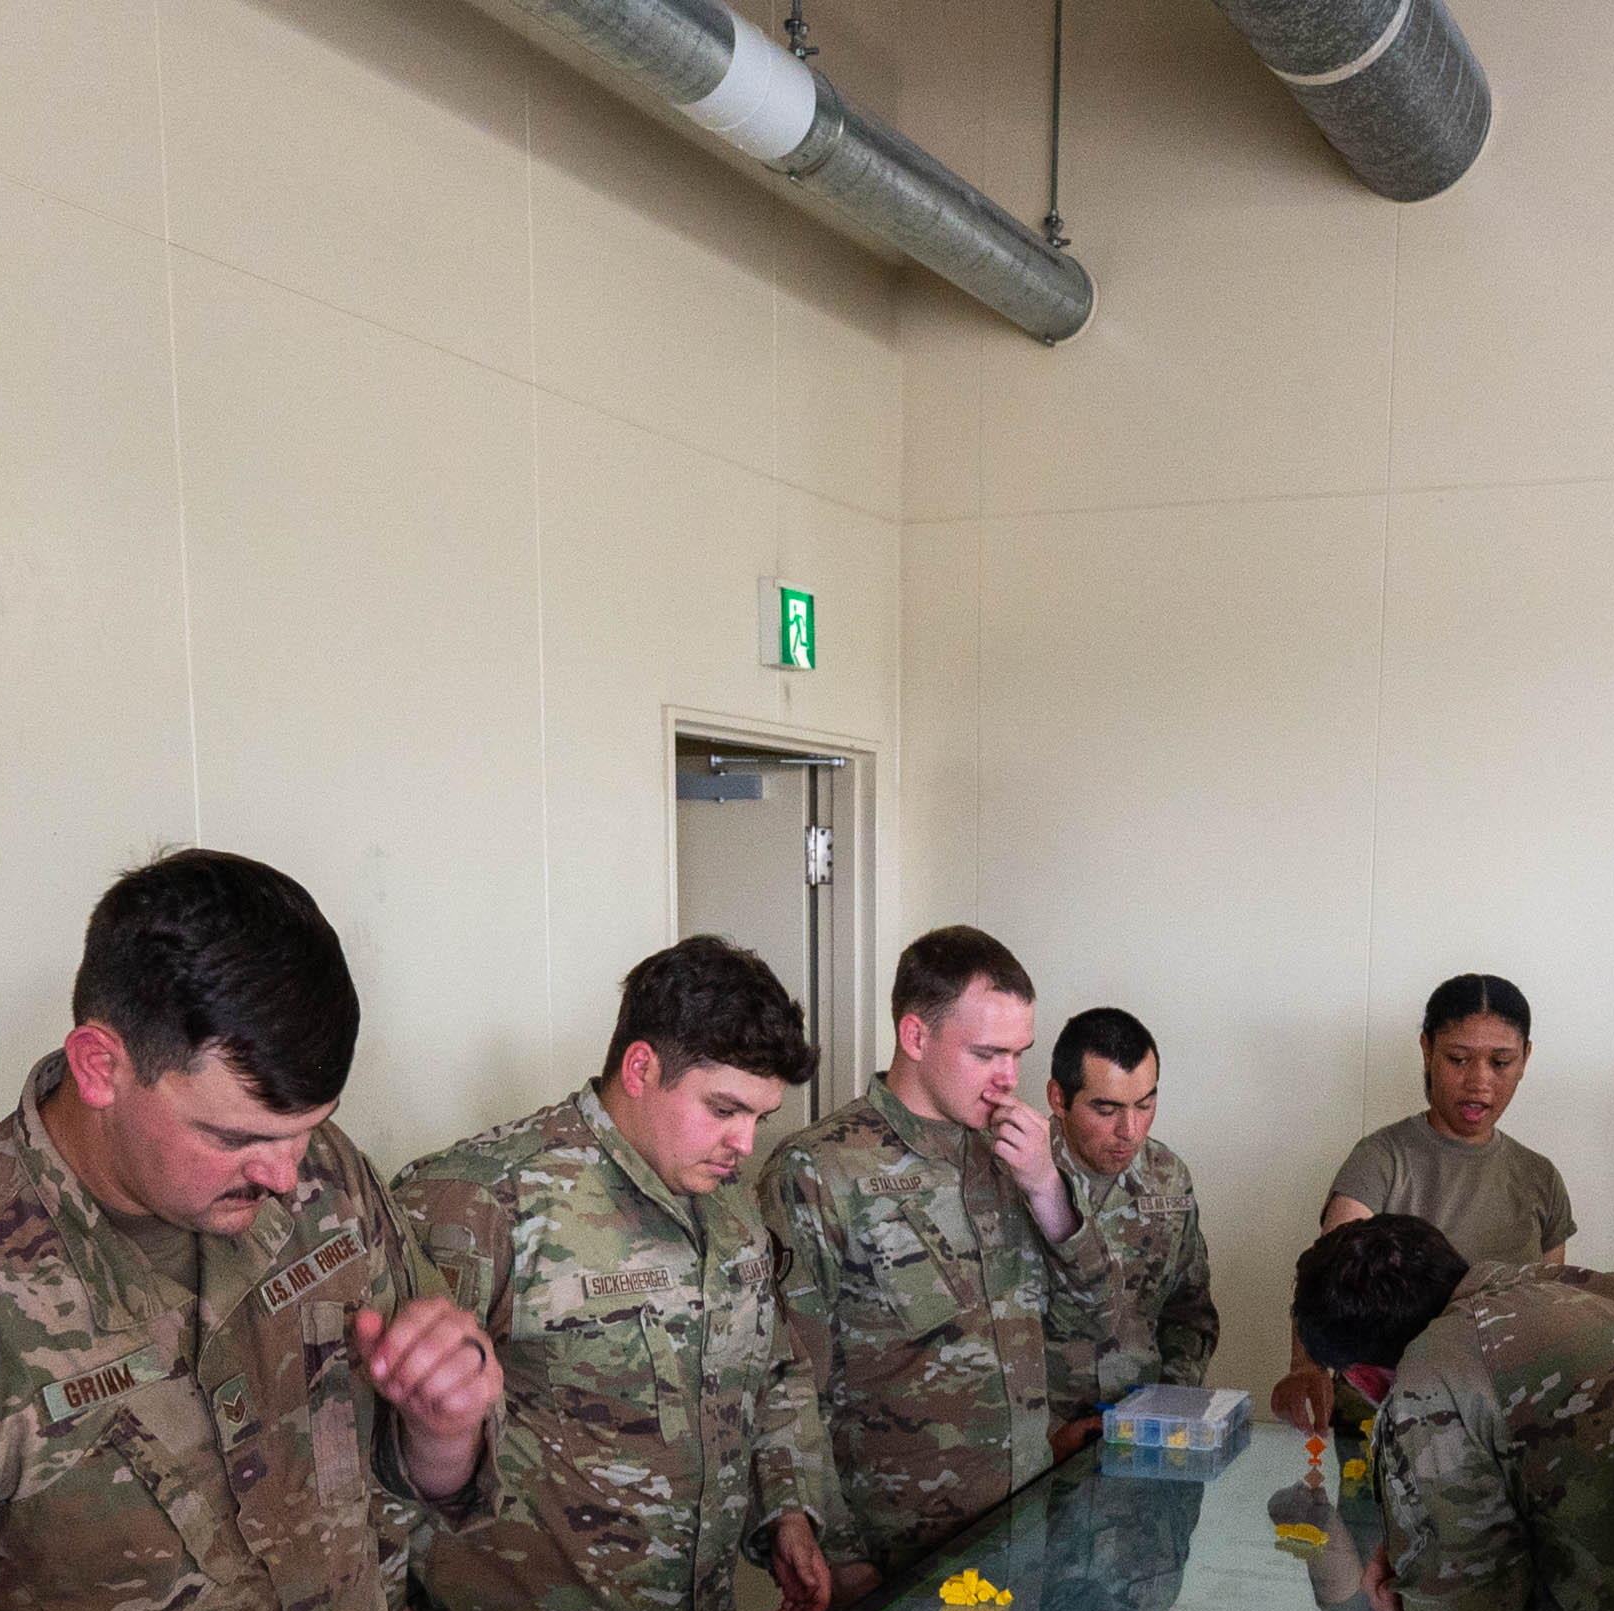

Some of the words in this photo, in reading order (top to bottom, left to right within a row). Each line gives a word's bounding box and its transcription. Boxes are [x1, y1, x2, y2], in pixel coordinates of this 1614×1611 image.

[869, 1175, 922, 1192] STALLCUP
[264, 1279, 292, 1307] U.S.
[289, 1265, 318, 1294] AIR
[316, 1233, 360, 1274] FORCE
[591, 1269, 670, 1296] SICKENBERGER
[62, 1363, 136, 1409] GRIMM
